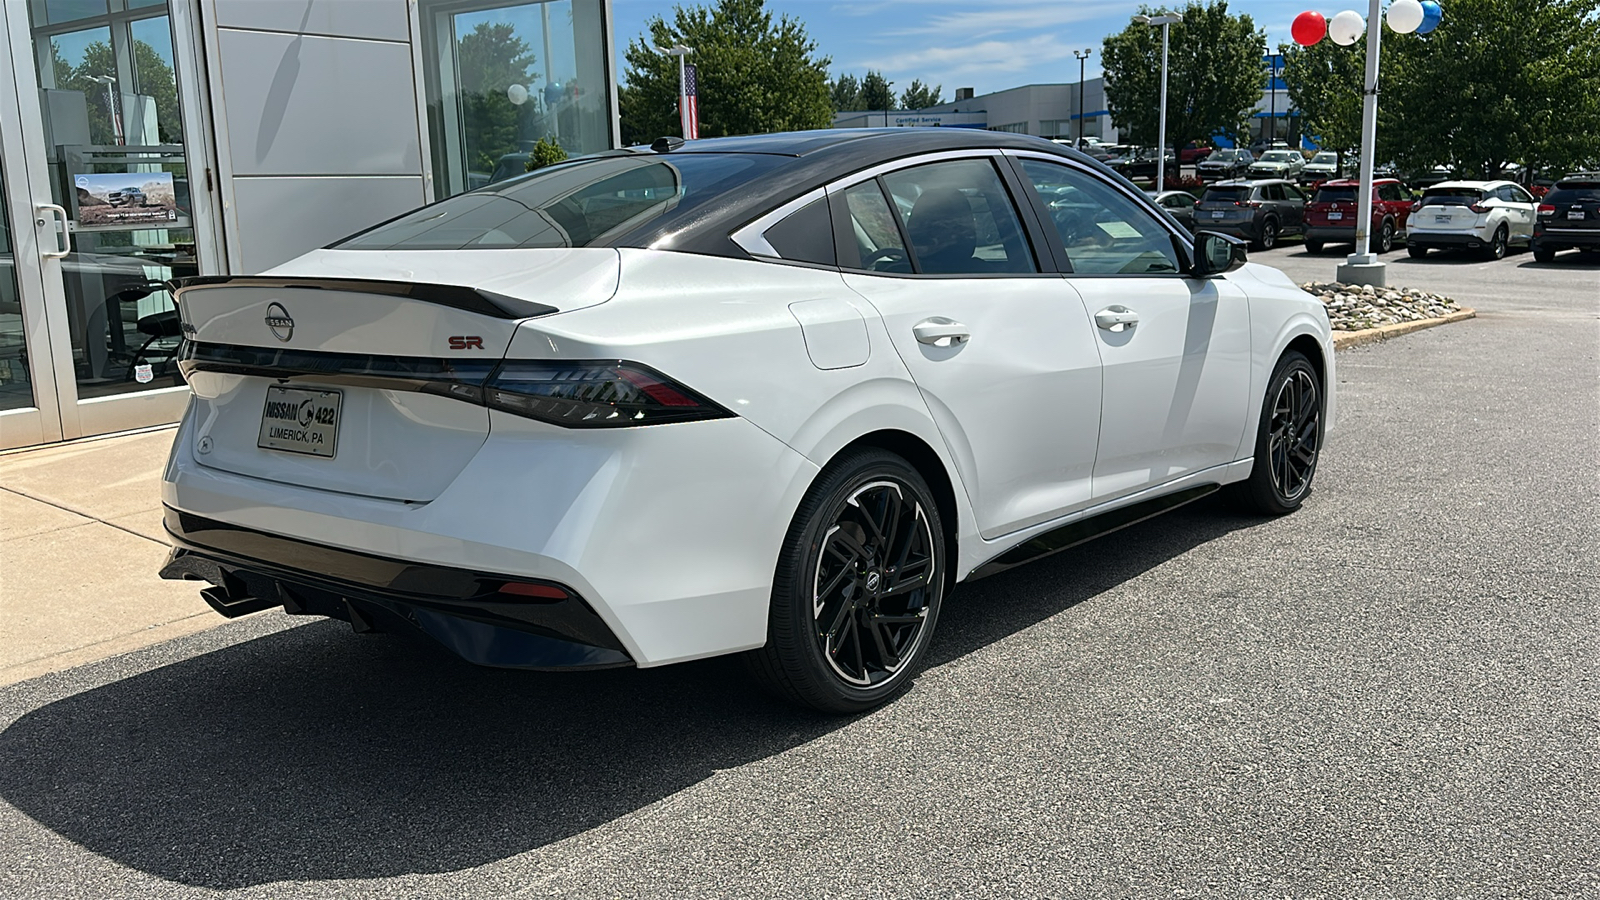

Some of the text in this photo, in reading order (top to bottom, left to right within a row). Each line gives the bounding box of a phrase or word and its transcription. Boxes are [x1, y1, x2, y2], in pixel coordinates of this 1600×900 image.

[448, 336, 485, 349] SR
[266, 401, 334, 425] NISSAN 422
[269, 427, 324, 444] LIMERICK, PA
